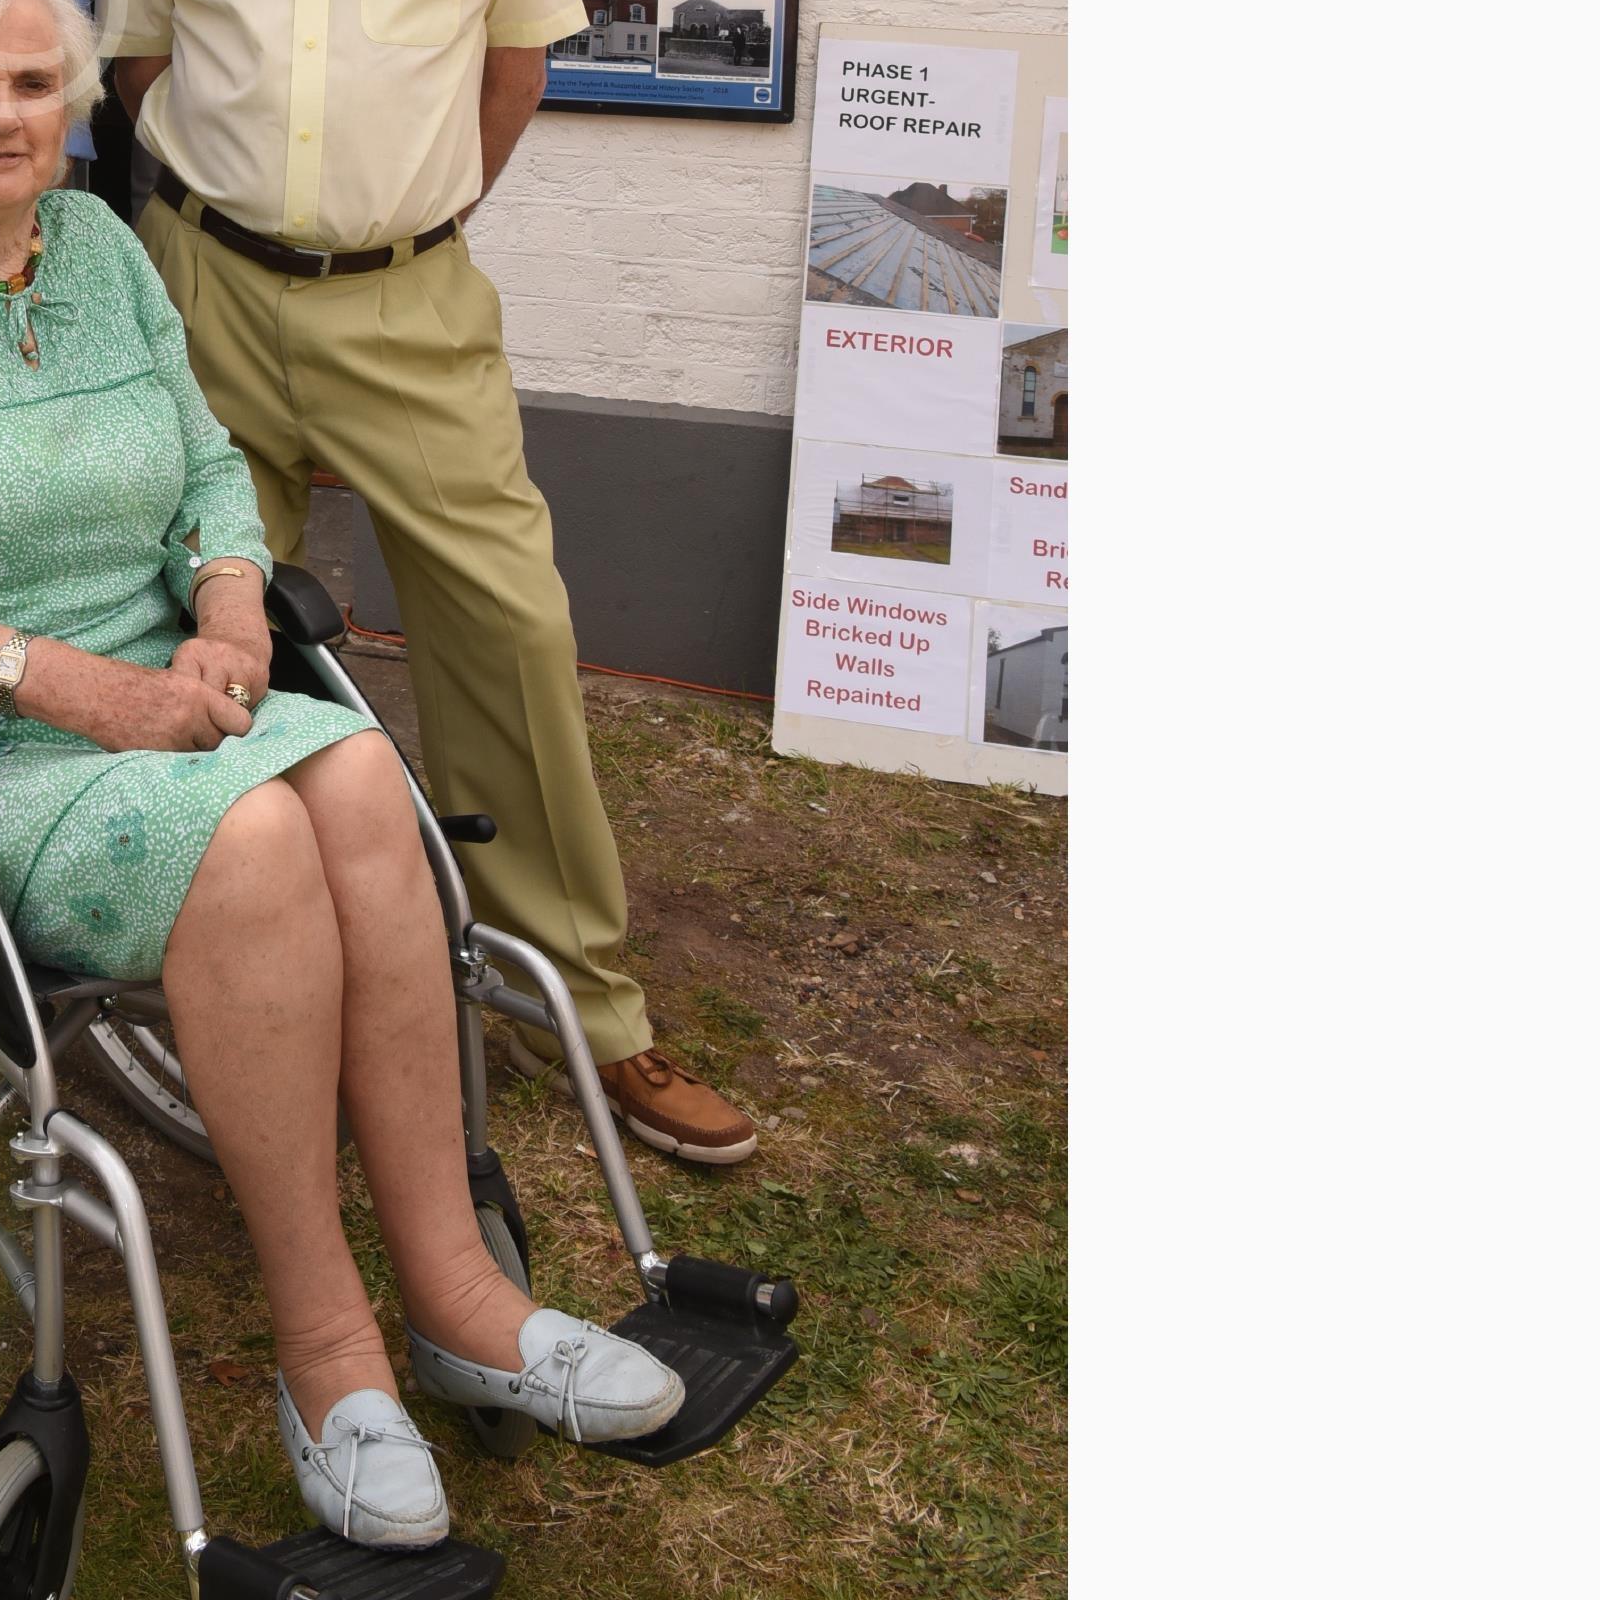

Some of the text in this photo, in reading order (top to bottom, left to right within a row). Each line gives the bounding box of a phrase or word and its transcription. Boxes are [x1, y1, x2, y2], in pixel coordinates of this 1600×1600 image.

[842, 61, 928, 82] PHASE 1
[841, 87, 936, 108] URGENT-
[839, 113, 982, 139] ROOF REPAIR
[826, 328, 953, 358] EXTERIOR
[1033, 539, 1068, 559] Bri
[792, 589, 947, 626] Side Windows
[806, 620, 930, 656] Bricked Up
[835, 653, 895, 678] Walls
[807, 680, 921, 712] Repainted
